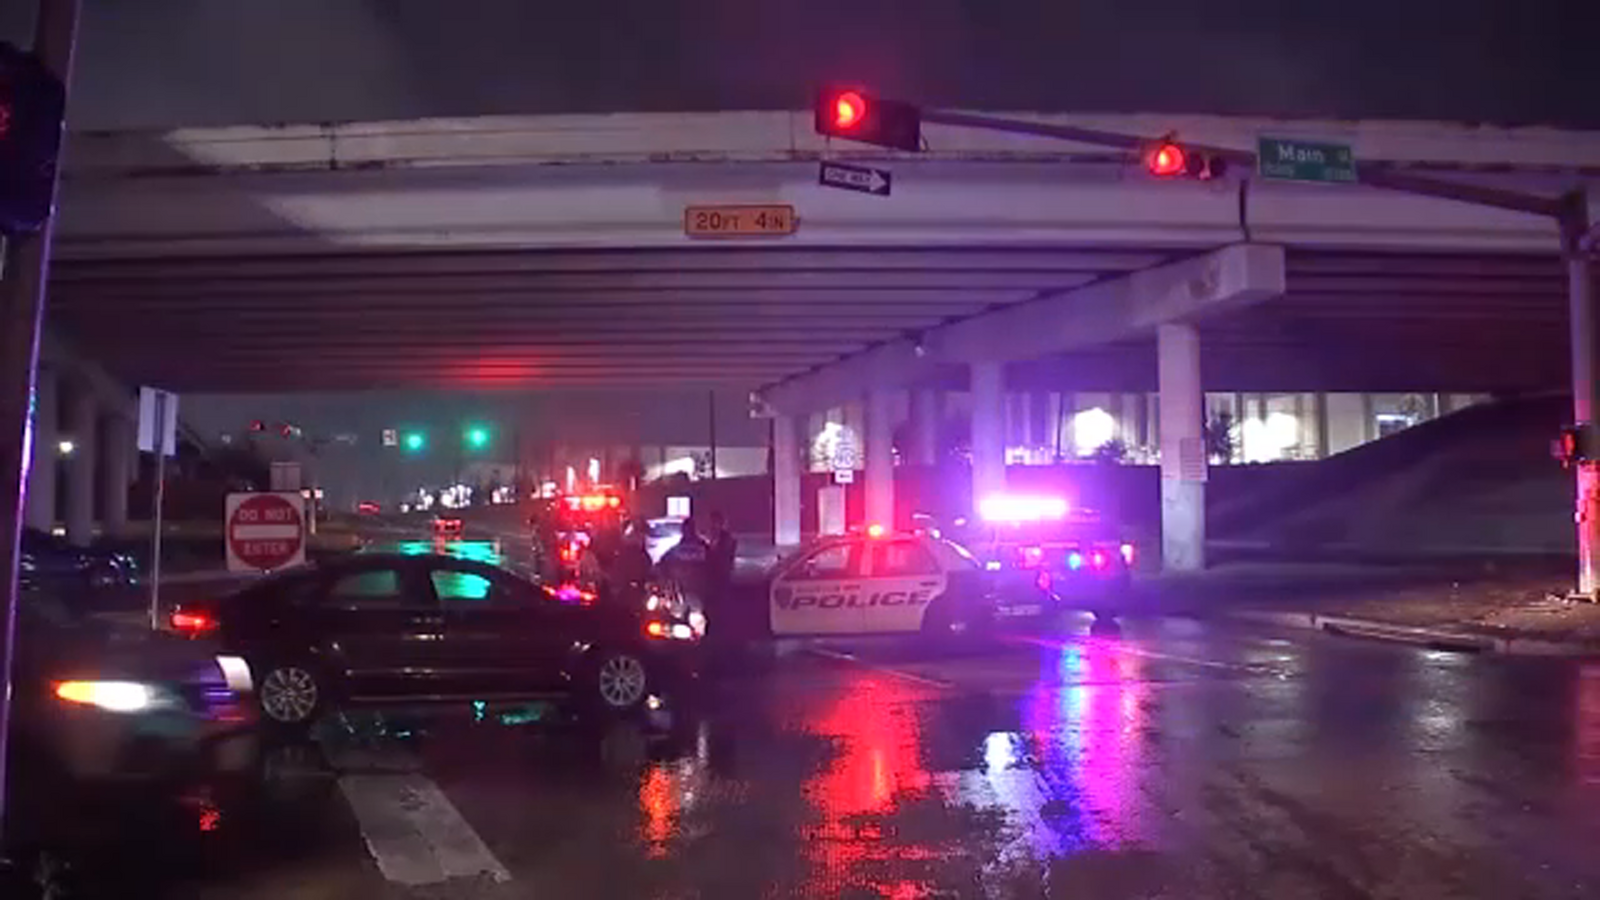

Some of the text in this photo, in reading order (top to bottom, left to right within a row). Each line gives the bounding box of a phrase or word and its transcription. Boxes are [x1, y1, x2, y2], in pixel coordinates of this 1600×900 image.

[1279, 143, 1325, 163] Main
[240, 508, 292, 521] DO NOT
[244, 542, 288, 556] ENTER
[791, 590, 932, 610] POLICE
